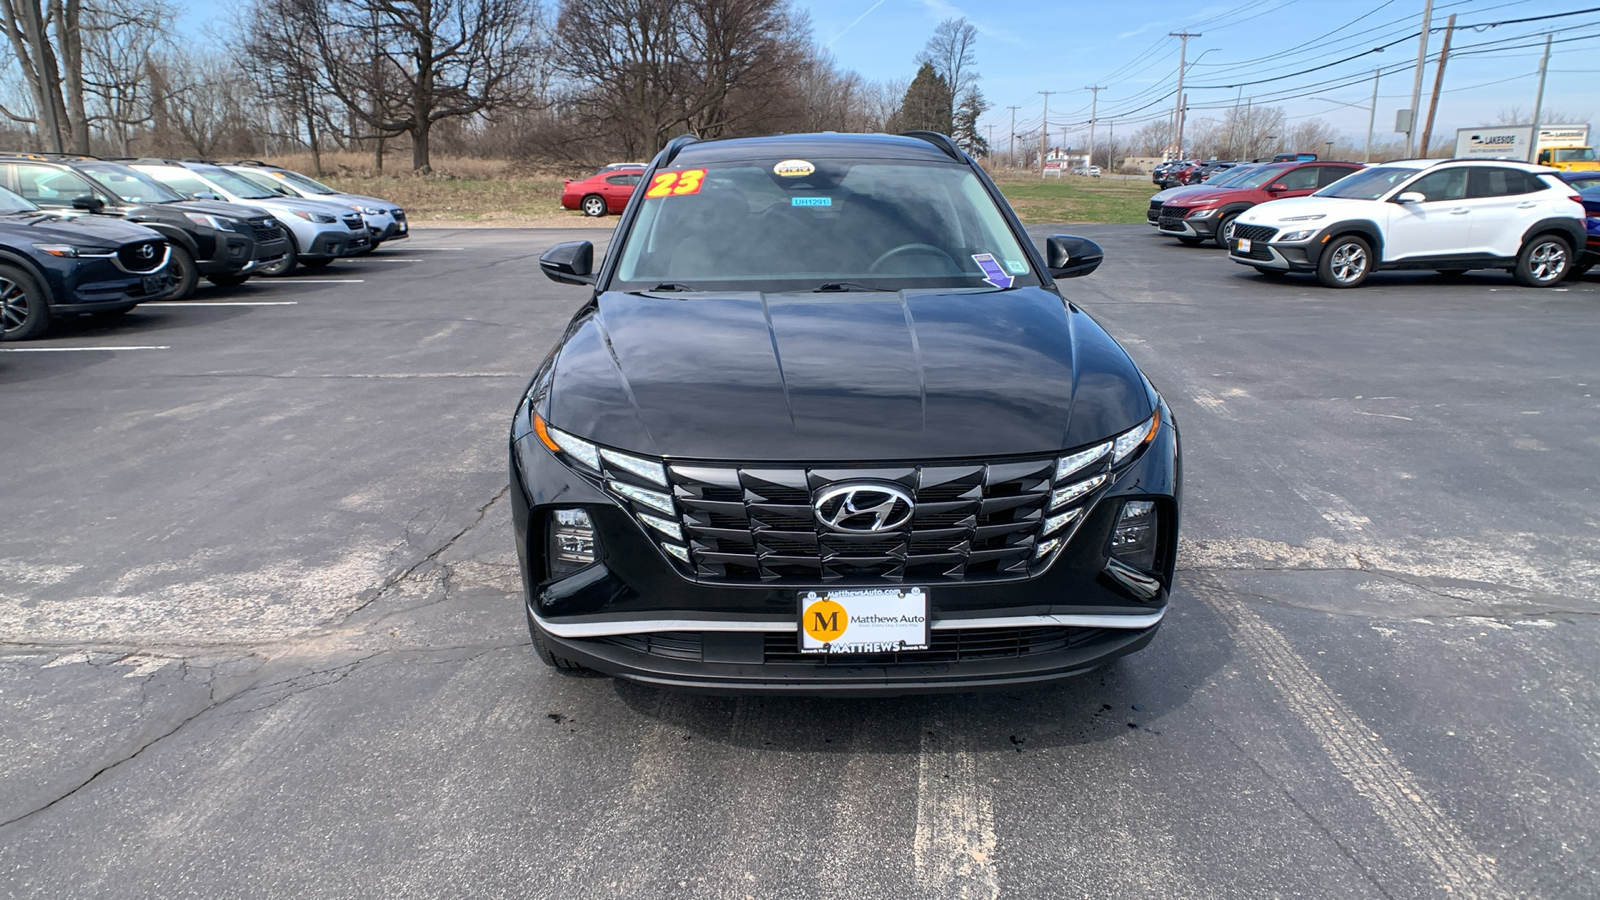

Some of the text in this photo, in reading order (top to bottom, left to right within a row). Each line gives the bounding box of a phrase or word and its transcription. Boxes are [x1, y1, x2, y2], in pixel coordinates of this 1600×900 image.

[1485, 135, 1516, 145] LAKESIDE
[647, 169, 704, 197] 23
[827, 589, 901, 598] MatthewsAuto.com
[812, 611, 840, 632] M
[850, 614, 925, 623] Matthews Auto
[829, 641, 900, 654] MATTHEWS
